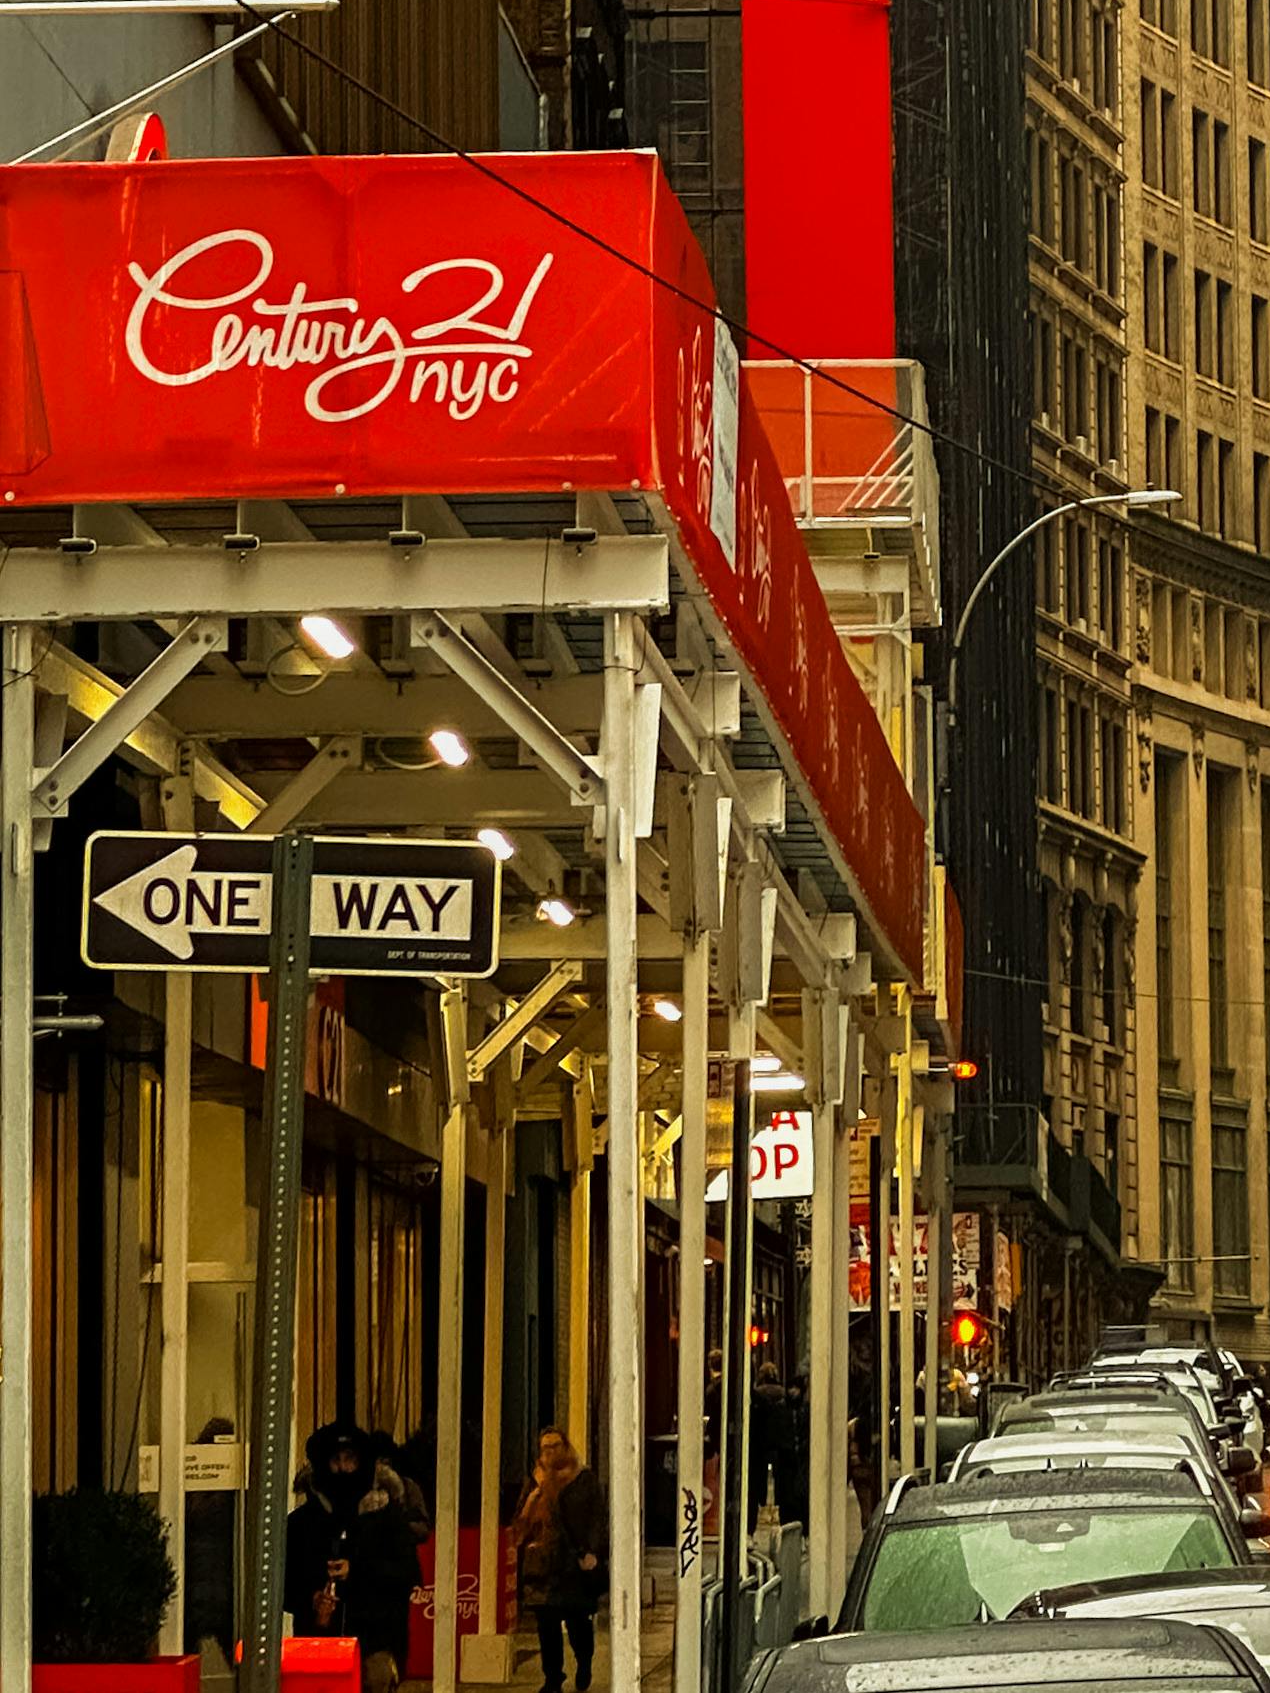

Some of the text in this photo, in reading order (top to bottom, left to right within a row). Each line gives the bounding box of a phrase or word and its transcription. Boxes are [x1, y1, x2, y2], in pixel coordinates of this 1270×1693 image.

[125, 228, 554, 423] Century 21
[410, 357, 518, 420] nyc
[143, 877, 461, 933] ONE WAY
